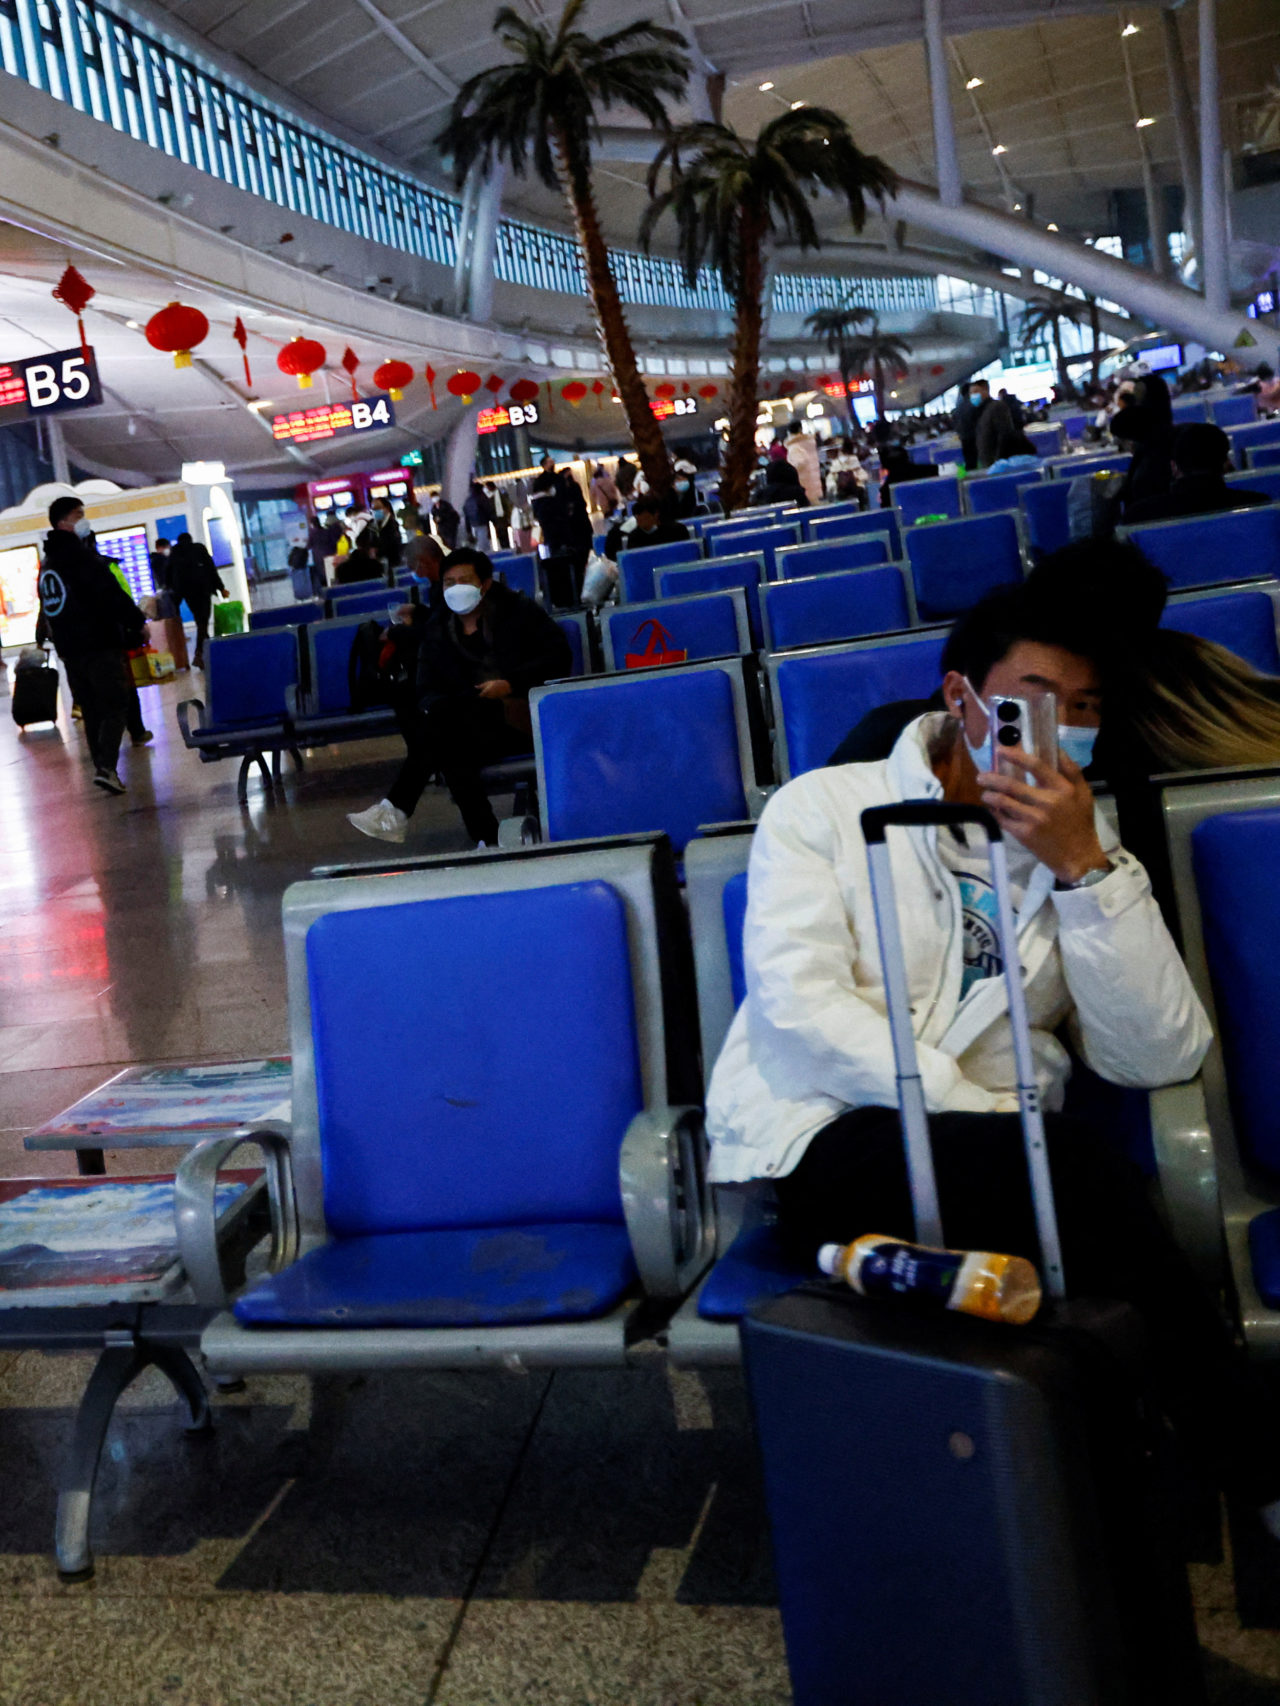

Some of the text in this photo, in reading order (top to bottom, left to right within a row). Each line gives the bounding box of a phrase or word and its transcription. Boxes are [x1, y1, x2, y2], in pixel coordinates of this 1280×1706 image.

[25, 357, 91, 408] B5
[352, 399, 390, 429] B4
[508, 403, 539, 427] B3
